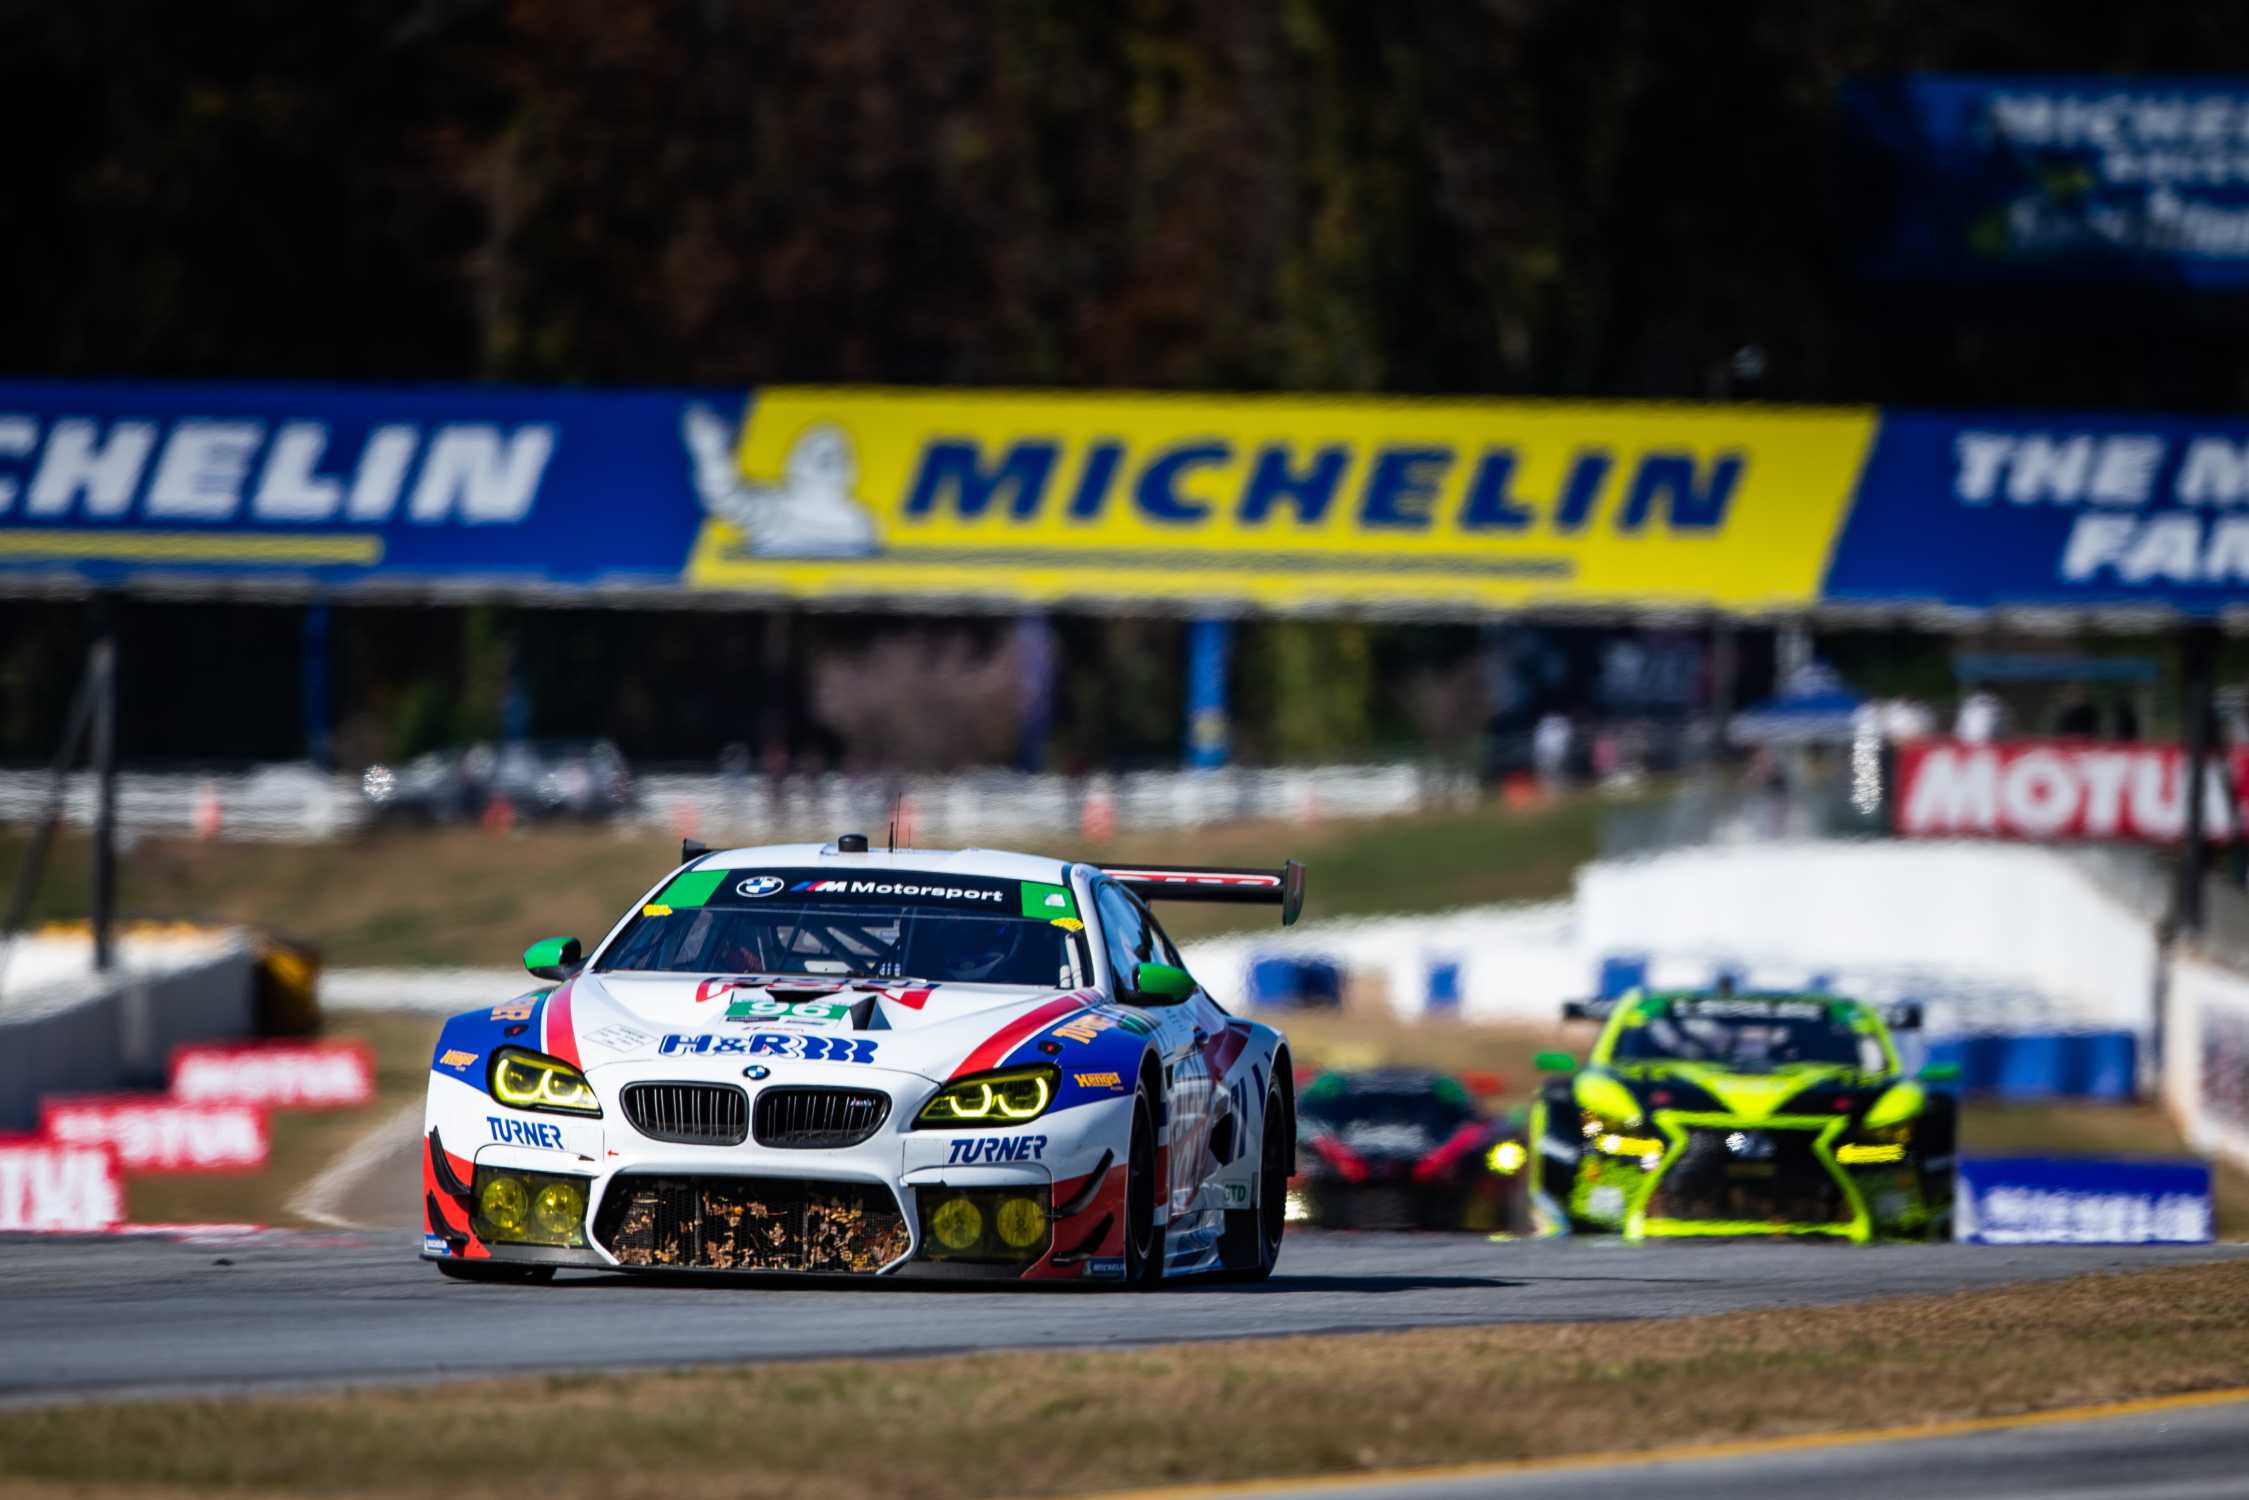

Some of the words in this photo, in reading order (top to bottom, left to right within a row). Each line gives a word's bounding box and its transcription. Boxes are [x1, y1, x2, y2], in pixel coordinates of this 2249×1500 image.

[1953, 432, 2166, 503] THE
[902, 435, 1748, 536] MICHELIN
[850, 882, 1004, 902] Motorsport
[748, 1001, 832, 1018] 96
[486, 1116, 565, 1150] TURNER
[948, 1135, 1048, 1164] TURNER
